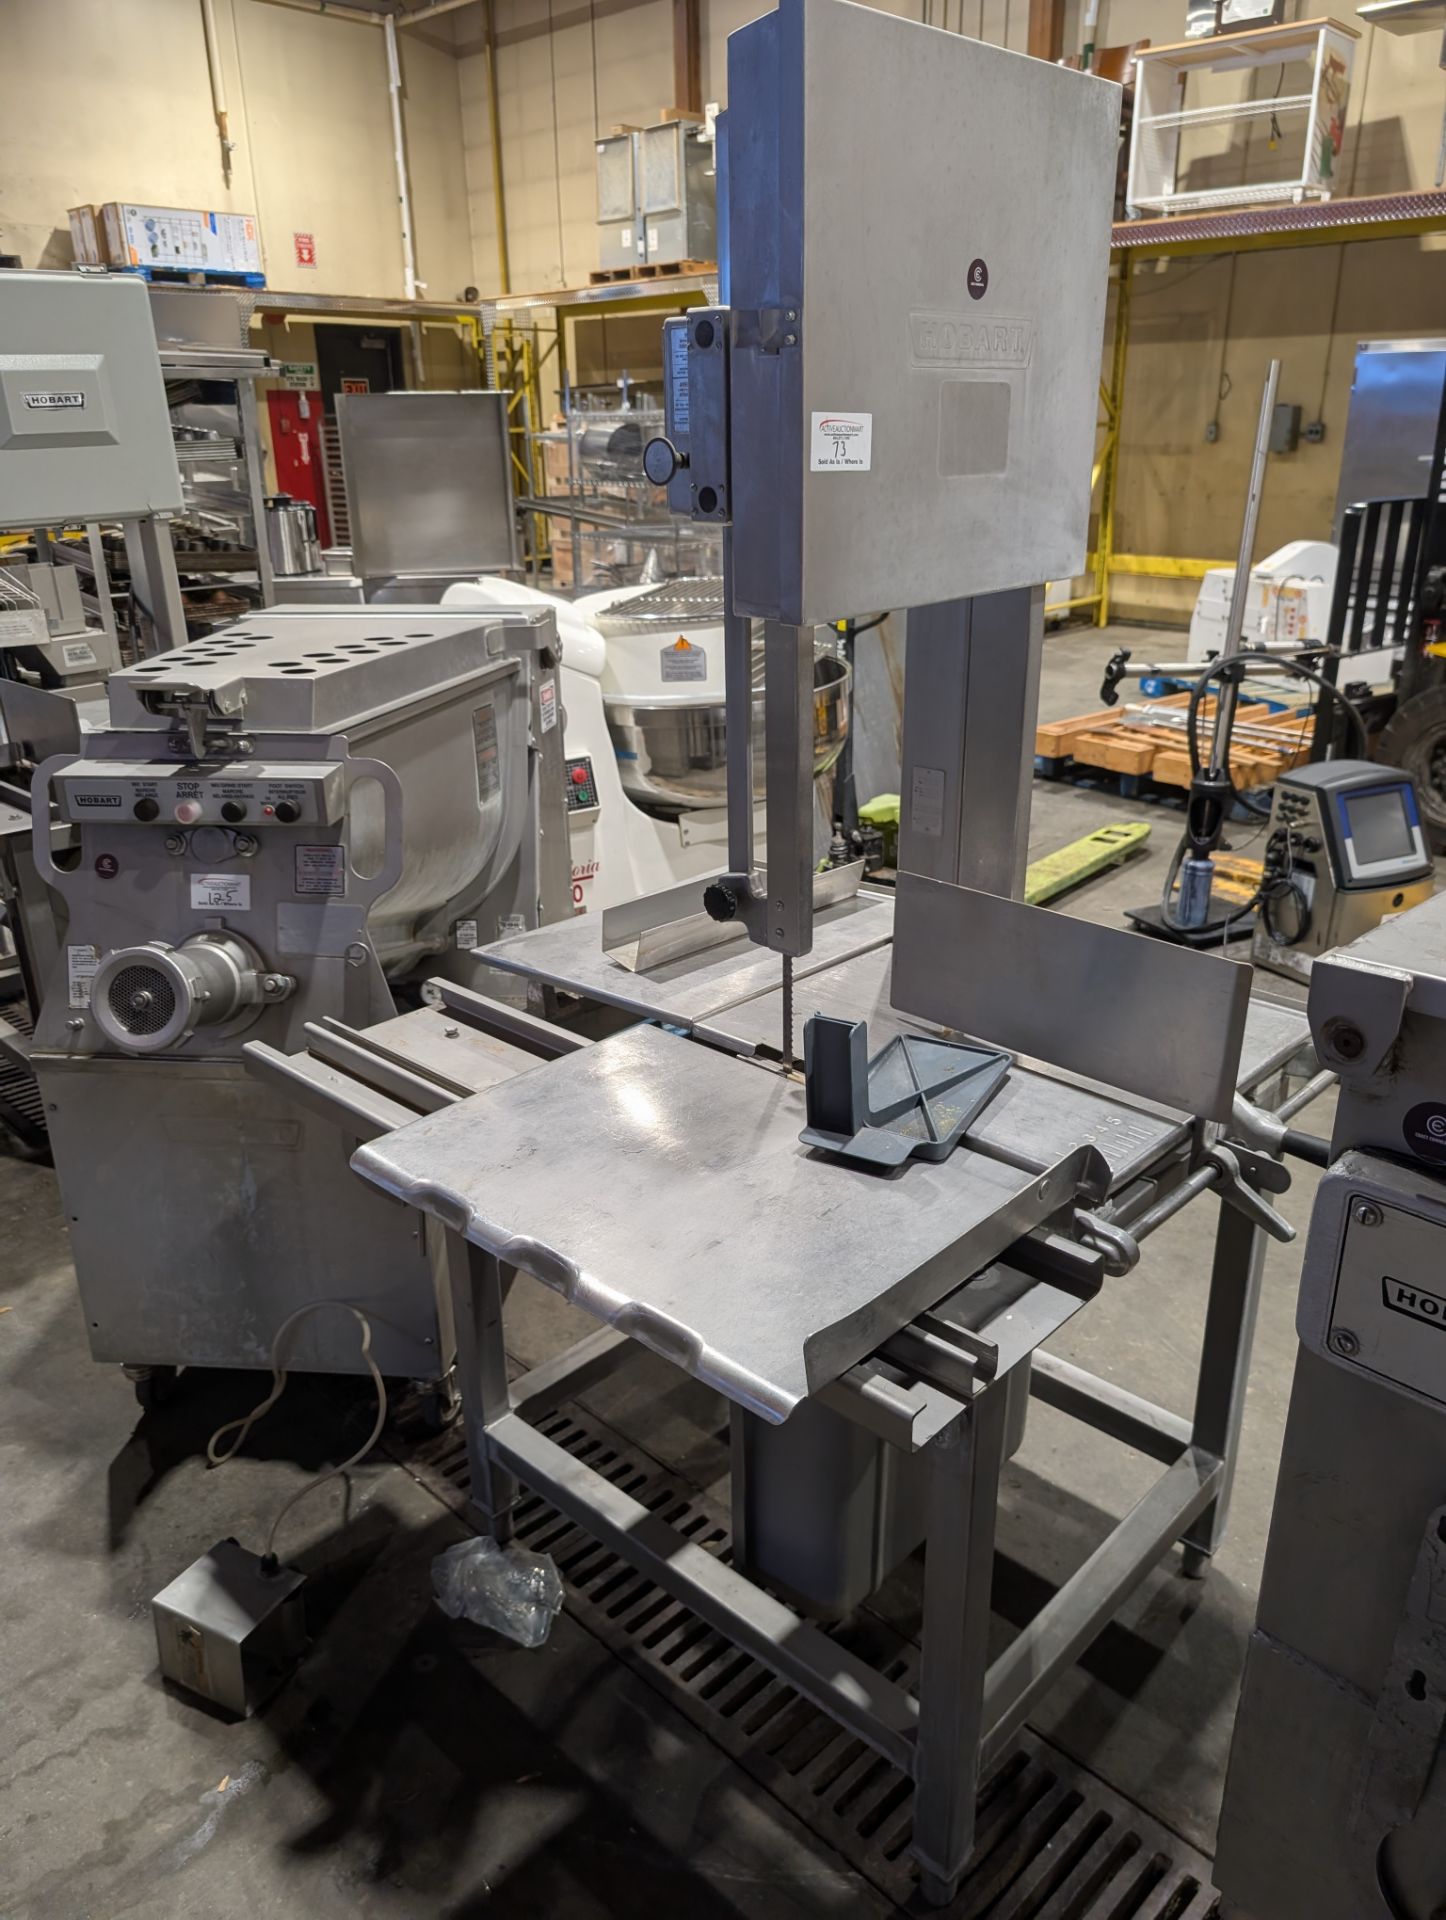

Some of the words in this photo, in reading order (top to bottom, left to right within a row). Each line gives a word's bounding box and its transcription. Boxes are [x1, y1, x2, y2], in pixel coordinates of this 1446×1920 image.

[920, 321, 1022, 352] HOBART
[31, 395, 79, 405] HOBART
[832, 440, 846, 458] 73
[176, 782, 200, 791] STOP
[208, 890, 239, 905] 125
[1396, 1287, 1446, 1321] HO
